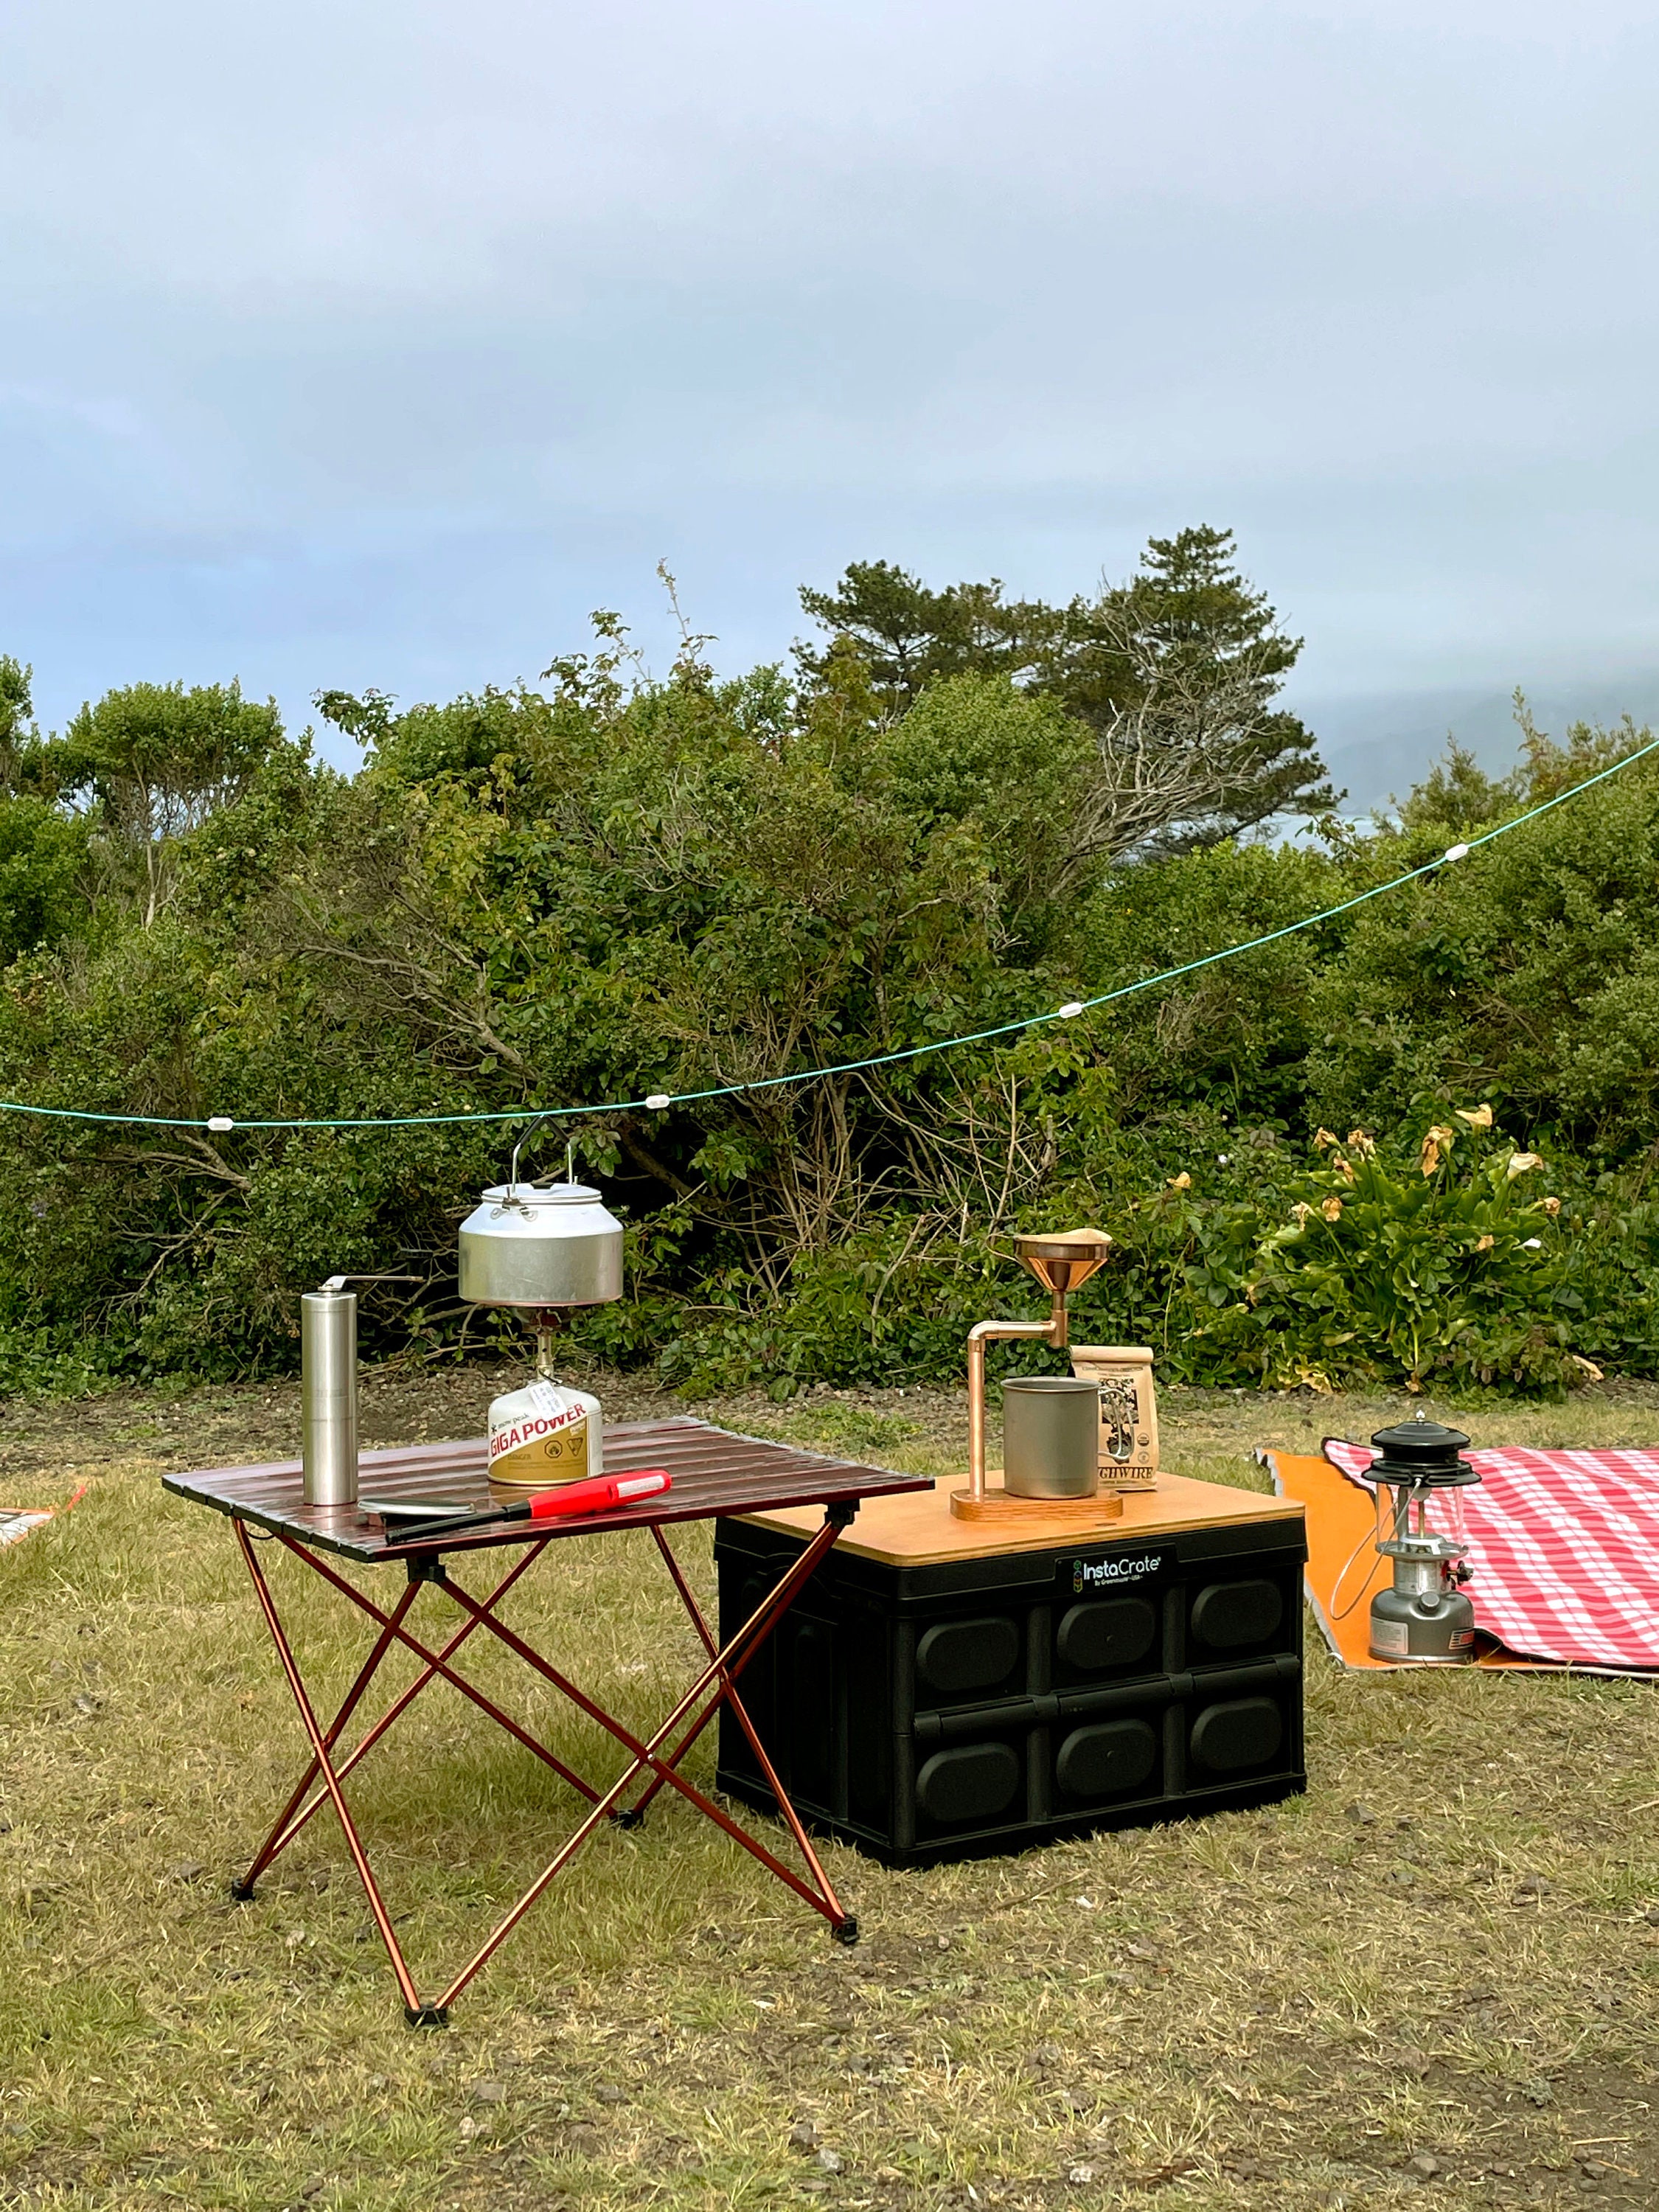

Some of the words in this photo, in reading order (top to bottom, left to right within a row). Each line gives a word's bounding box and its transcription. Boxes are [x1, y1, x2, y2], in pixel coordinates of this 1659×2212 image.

[490, 1428, 521, 1458] GIGA
[522, 1403, 586, 1440] POWER
[1097, 1467, 1153, 1479] GHWIRE
